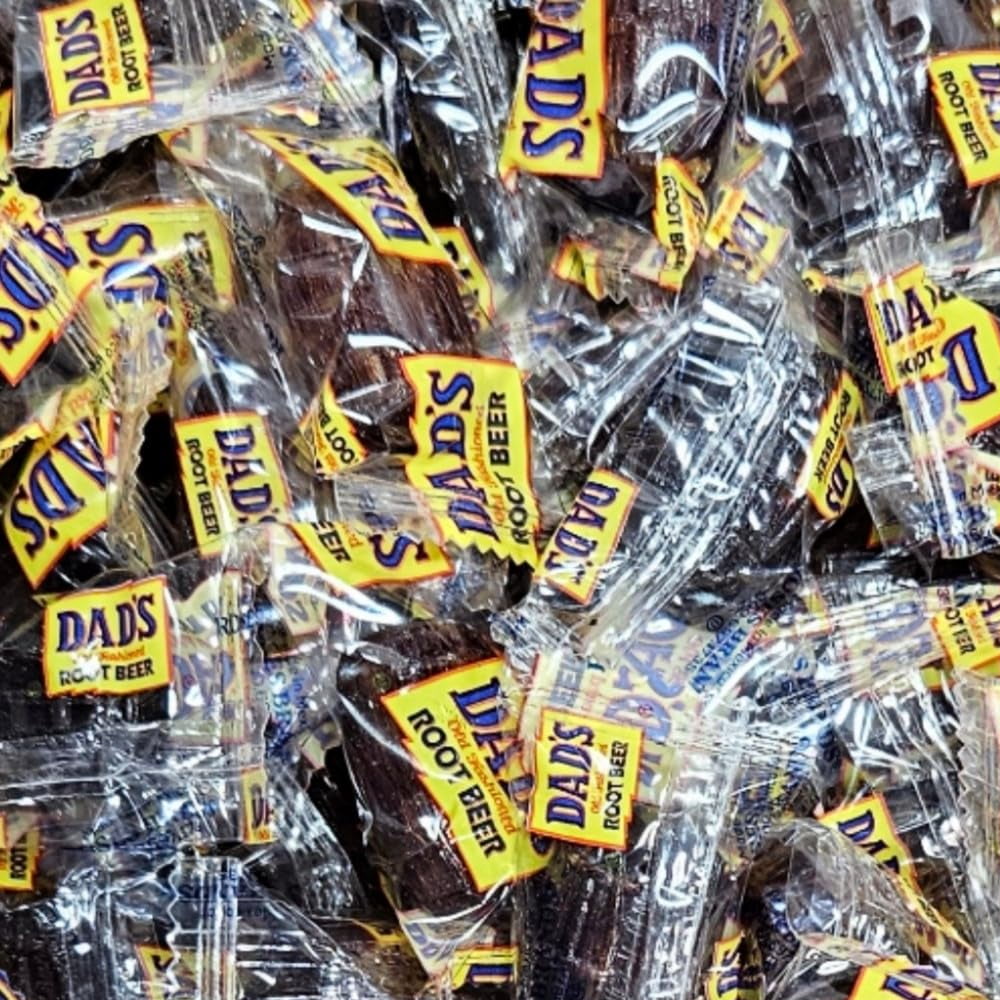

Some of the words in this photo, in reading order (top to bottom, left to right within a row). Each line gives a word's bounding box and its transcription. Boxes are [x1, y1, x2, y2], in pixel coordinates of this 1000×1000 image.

[58, 9, 112, 105] DAD'S
[114, 3, 138, 46] BEER
[123, 49, 143, 93] ROOT
[938, 70, 970, 124] ROOT
[959, 122, 988, 162] BEER
[0, 221, 79, 351] AD'S
[426, 368, 500, 542] DAD'S
[486, 391, 511, 468] BEER
[12, 420, 113, 559] AD'S
[186, 438, 209, 492] ROOT
[198, 491, 220, 536] BEER
[500, 473, 532, 547] ROOT
[545, 479, 618, 586] DAD'S
[57, 593, 159, 654] DAD'S
[115, 659, 155, 682] BEER
[408, 708, 472, 784] ROOT
[458, 783, 506, 859] BEER
[546, 720, 596, 830] DAD'S
[602, 777, 625, 831] ROOT
[607, 739, 630, 778] BEER
